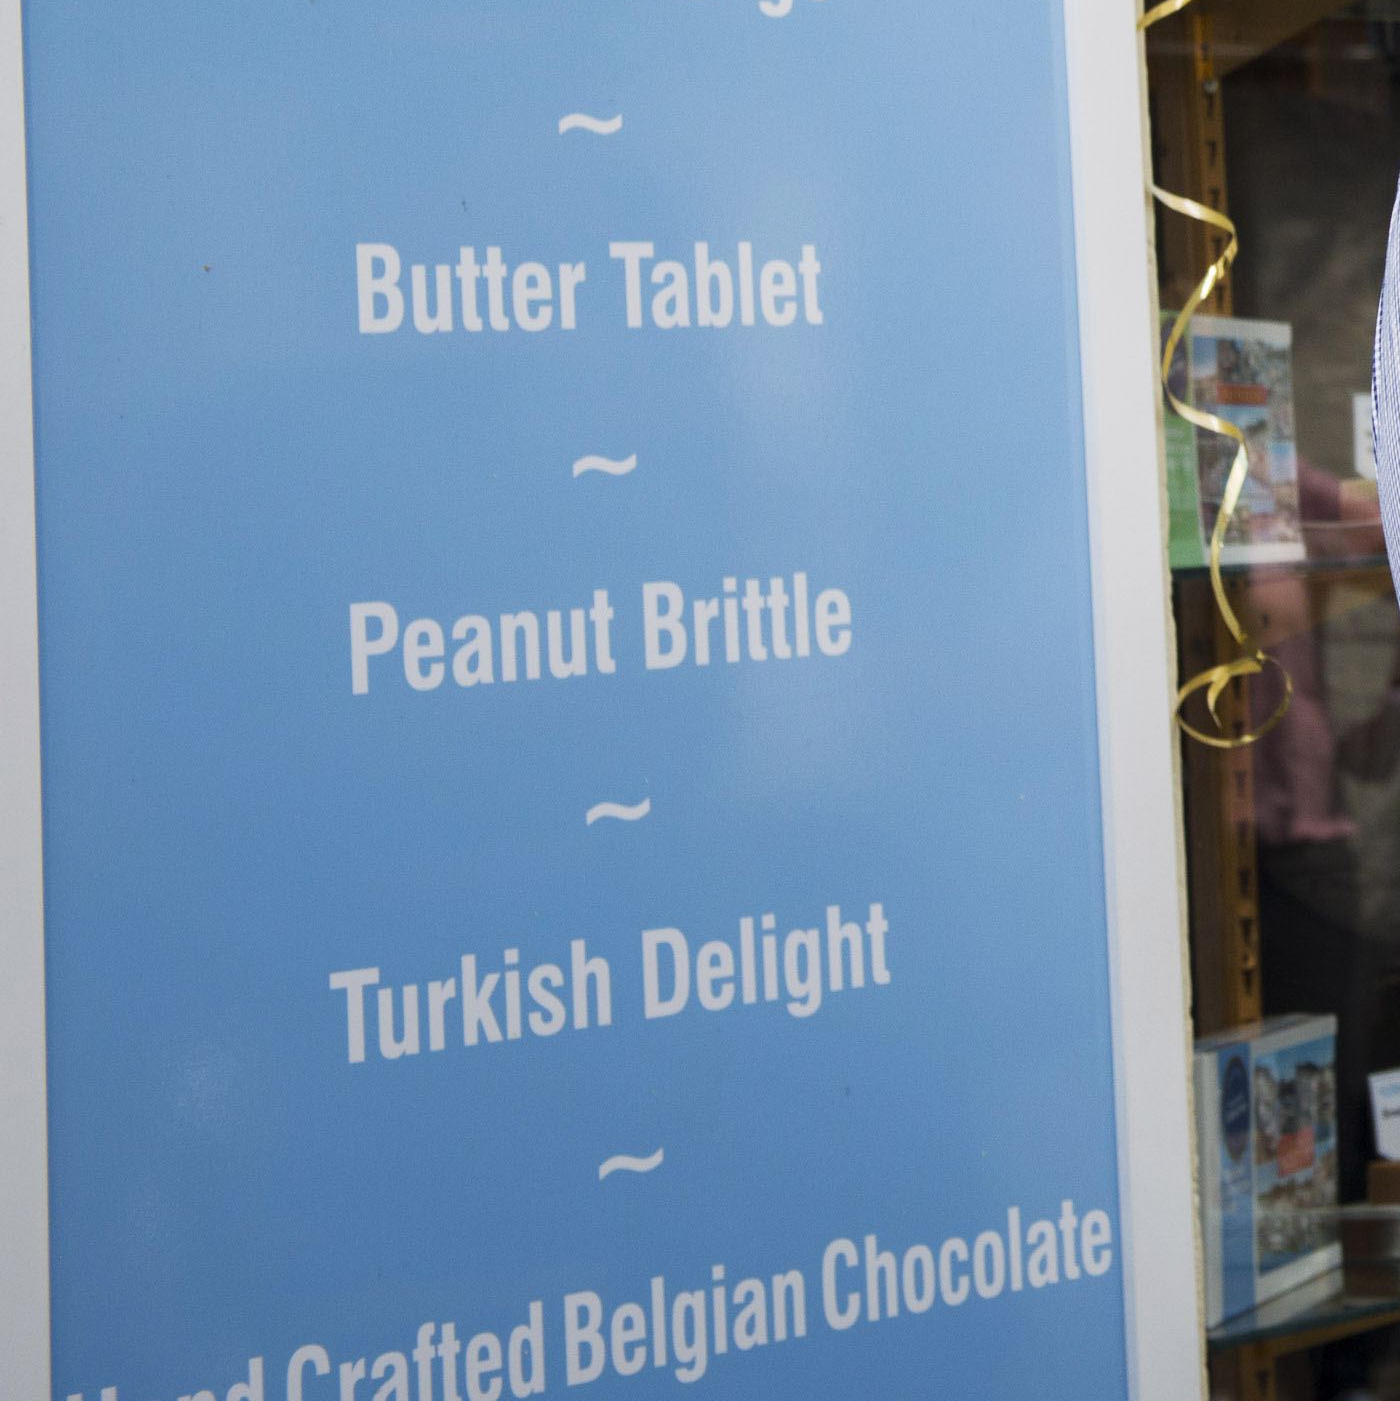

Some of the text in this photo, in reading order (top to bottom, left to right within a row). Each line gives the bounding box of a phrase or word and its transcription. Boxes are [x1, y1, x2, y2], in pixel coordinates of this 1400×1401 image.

[356, 241, 824, 334] Butter Tablet
[349, 571, 852, 695] Peanut Brittle
[329, 902, 891, 1064] Turkish Delight
[287, 1198, 1113, 1401] Crafted Belgian Chocolate
